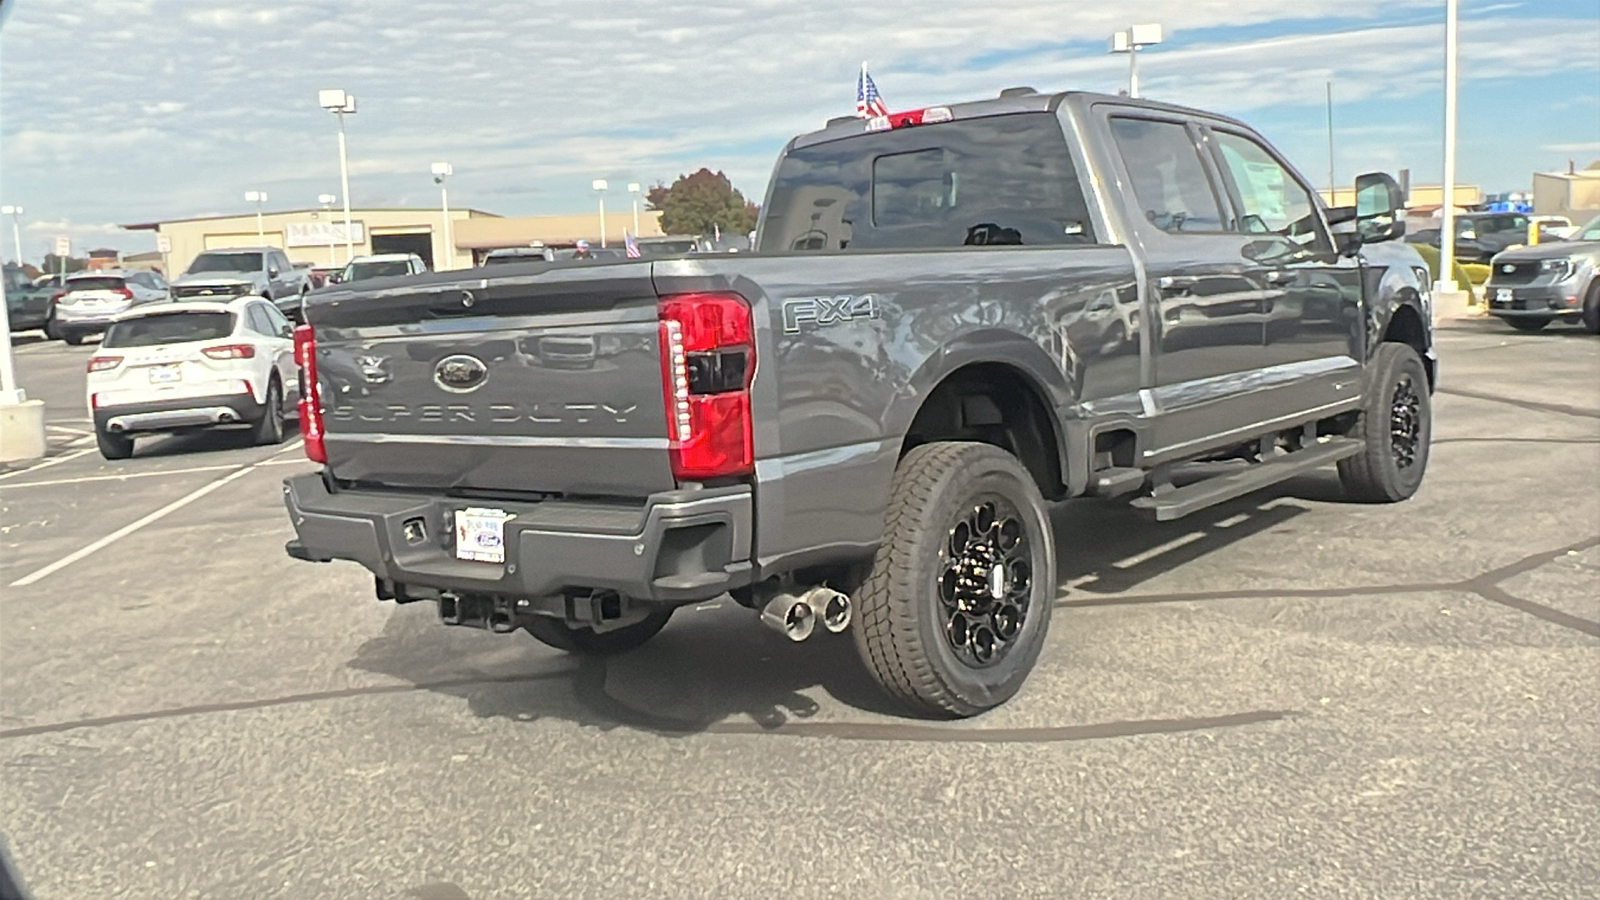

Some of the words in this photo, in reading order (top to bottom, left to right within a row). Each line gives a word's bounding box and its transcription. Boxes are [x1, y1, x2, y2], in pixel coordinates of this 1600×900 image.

[782, 294, 880, 335] FX4
[334, 405, 475, 422] SUPER
[489, 404, 637, 423] DUTY
